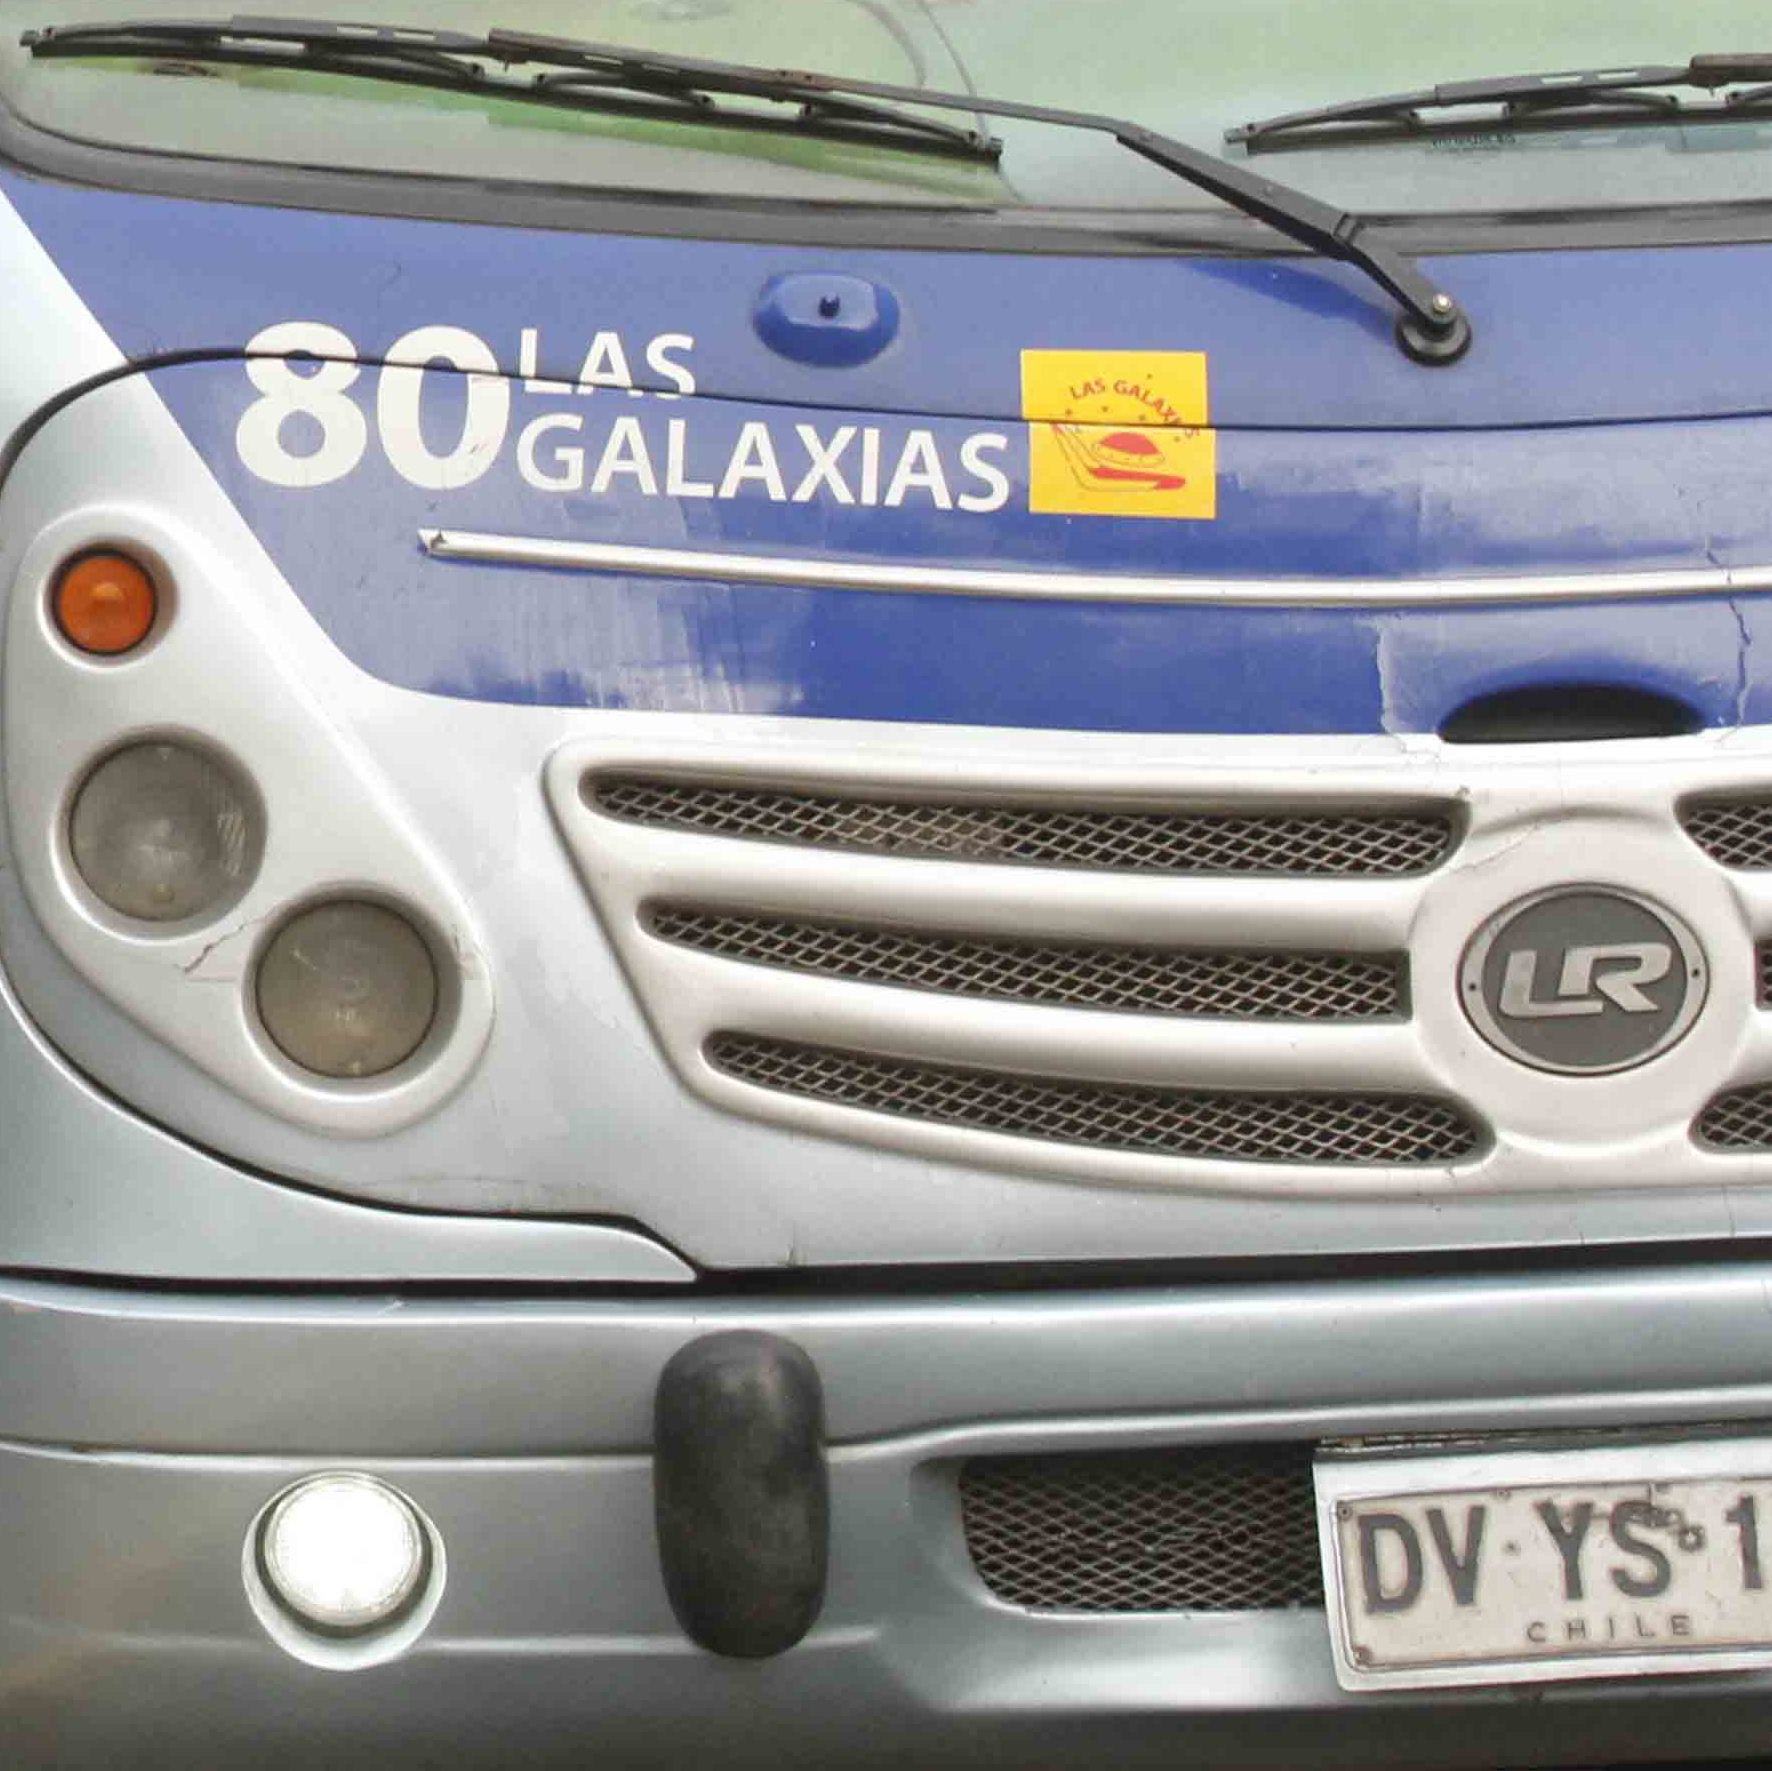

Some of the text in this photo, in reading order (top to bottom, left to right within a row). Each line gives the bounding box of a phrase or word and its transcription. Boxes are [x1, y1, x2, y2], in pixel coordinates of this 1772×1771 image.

[236, 320, 697, 490] 80 LAS
[1069, 377, 1107, 400] LAS
[516, 414, 1009, 514] GALAXIAS
[1499, 941, 1672, 1020] LR
[1525, 1615, 1693, 1645] CHILE
